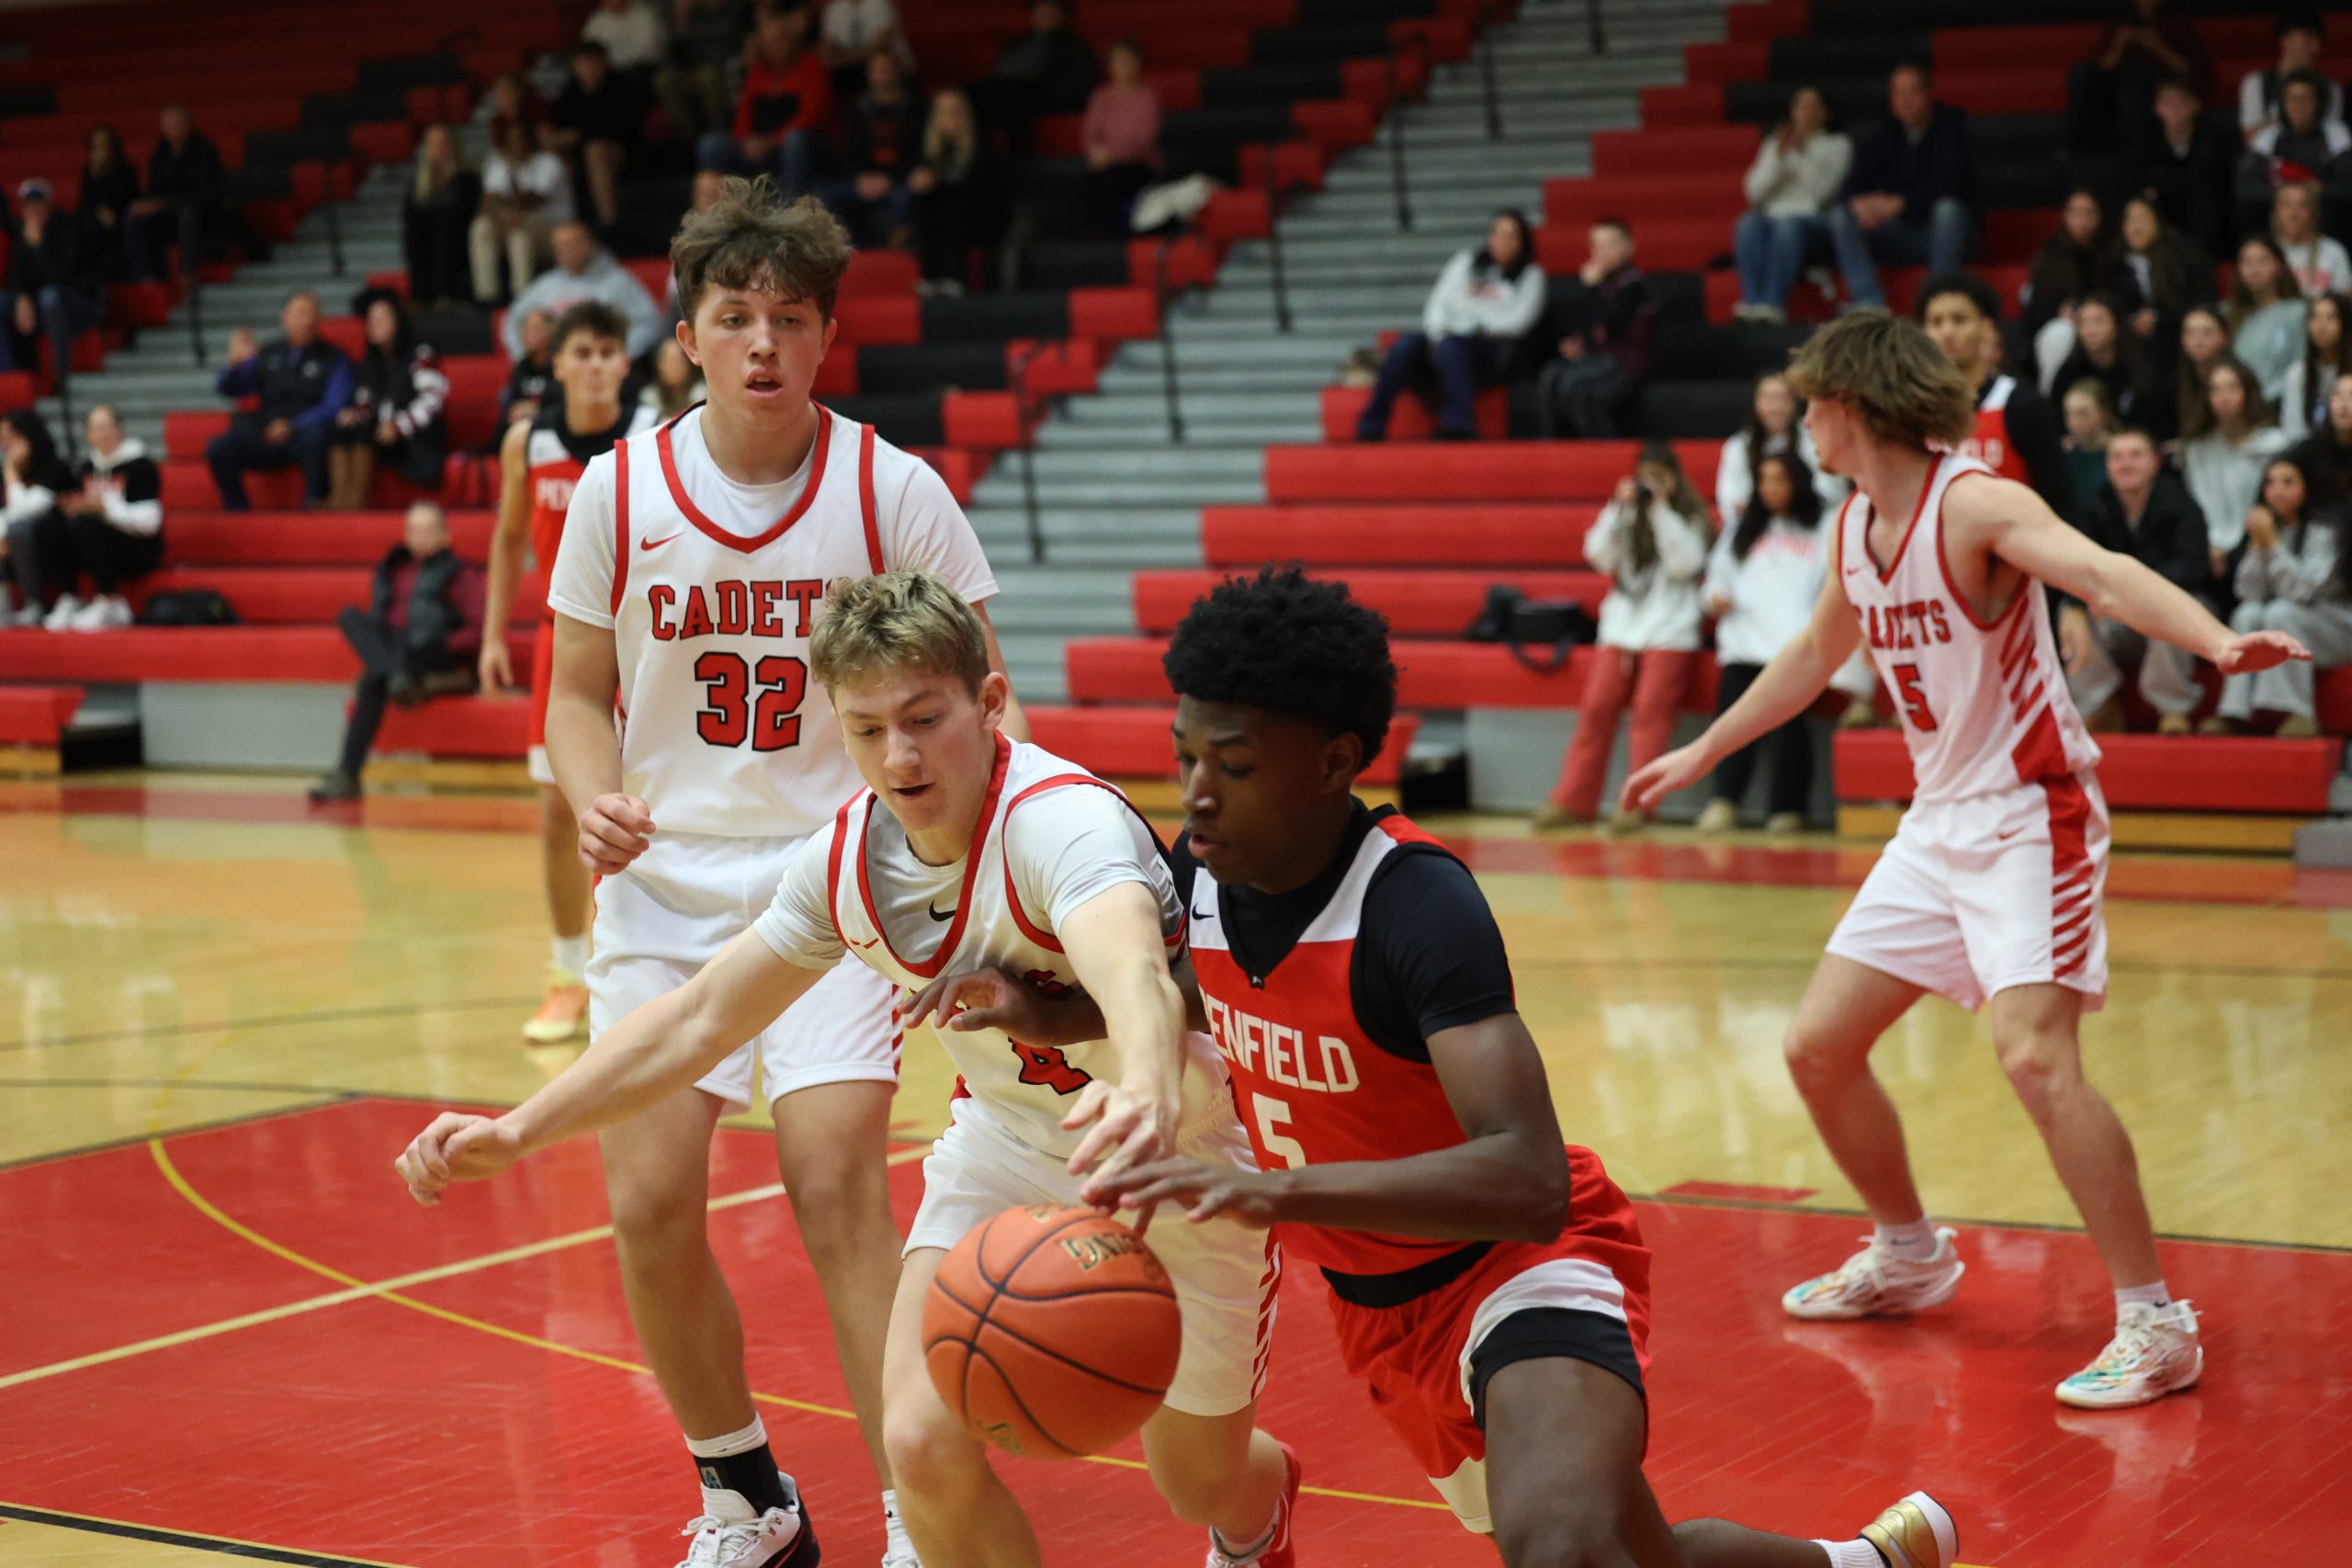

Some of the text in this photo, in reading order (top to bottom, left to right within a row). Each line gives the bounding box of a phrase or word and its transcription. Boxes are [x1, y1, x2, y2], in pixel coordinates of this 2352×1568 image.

[648, 580, 832, 641] CADET
[695, 651, 808, 752] 32
[1893, 664, 1938, 732] 5
[1198, 984, 1361, 1093] ENFIELD
[1252, 1091, 1307, 1171] 5
